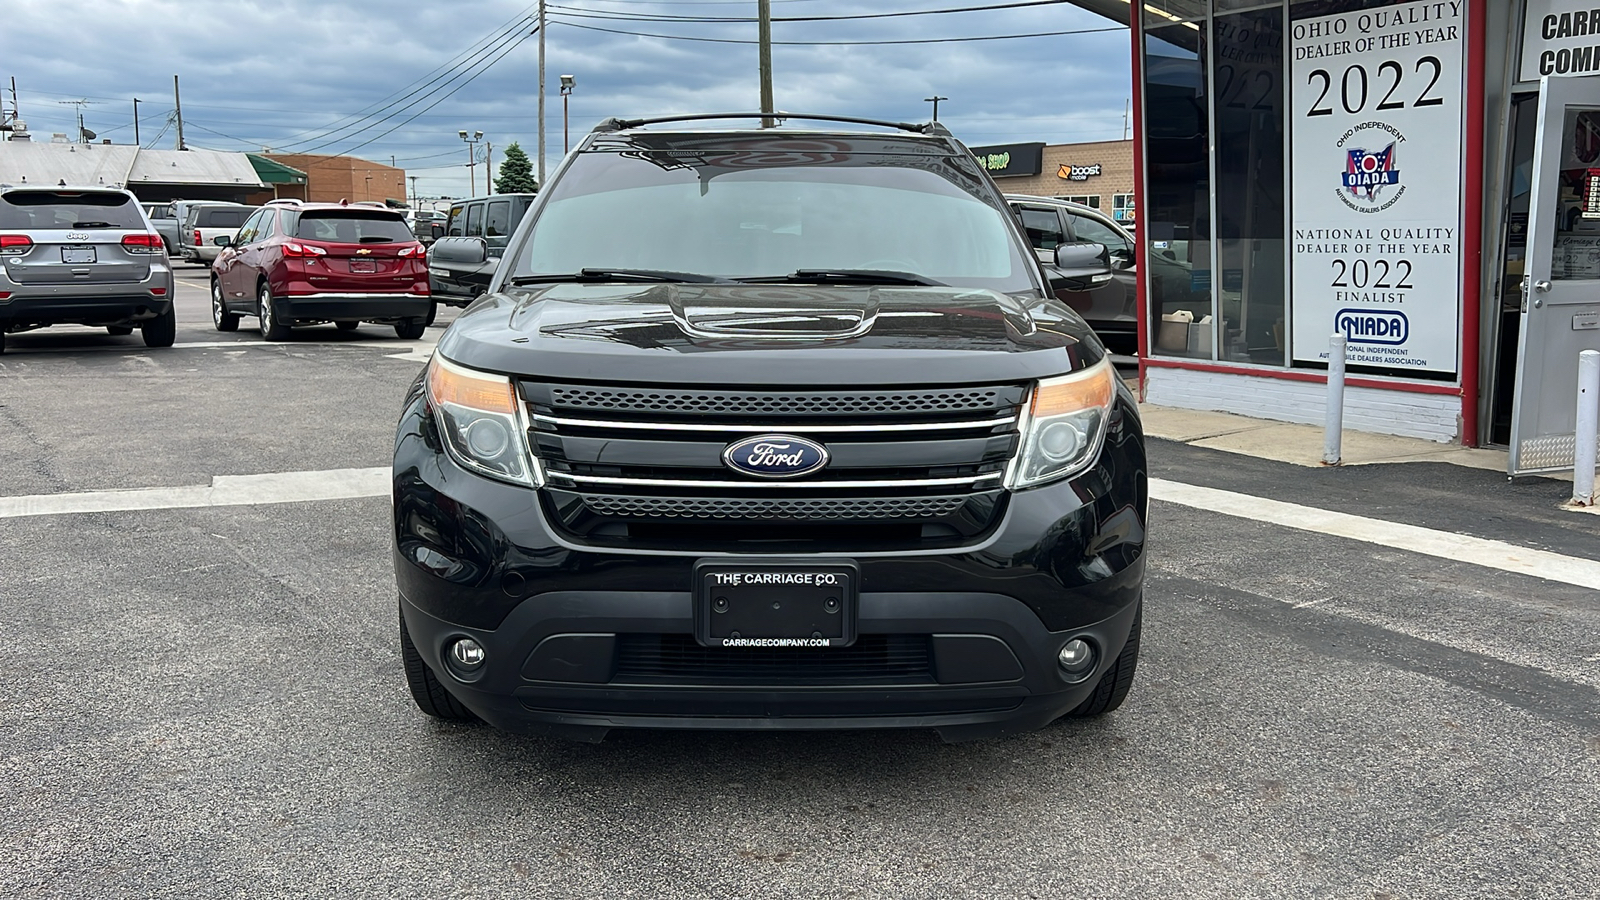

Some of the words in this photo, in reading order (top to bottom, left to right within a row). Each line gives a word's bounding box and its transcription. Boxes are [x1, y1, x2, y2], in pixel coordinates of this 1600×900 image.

[1293, 18, 1347, 40] OHIO
[1357, 0, 1461, 33] QUALITY
[1541, 9, 1600, 40] CARR
[1295, 40, 1351, 60] DEALER
[1355, 37, 1375, 53] OF
[1378, 32, 1410, 50] THE
[1414, 25, 1458, 45] YEAR
[1306, 55, 1443, 117] 2022
[1336, 129, 1354, 148] OHIO
[1353, 121, 1407, 144] INDEPENDENT
[988, 152, 1010, 170] SHOP
[1071, 164, 1100, 176] boost
[1348, 172, 1389, 186] OIADA
[1335, 188, 1359, 212] AUTOMOBILE
[1359, 206, 1380, 214] DEALERS
[1380, 185, 1407, 211] ASSOCIATION
[66, 232, 89, 241] Jeep
[1295, 229, 1374, 240] NATIONAL
[1380, 228, 1454, 241] QUALITY
[1297, 244, 1348, 254] DEALER
[1354, 244, 1372, 254] OF
[1378, 244, 1406, 254] THE
[1412, 244, 1451, 254] YEAR
[1331, 259, 1414, 289] 2022
[1336, 291, 1406, 303] FINALIST
[1341, 316, 1401, 337] NIADA
[1366, 347, 1408, 355] INDEPENDENT
[1357, 355, 1383, 363] DEALERS
[1384, 357, 1427, 366] ASSOCIATION
[747, 442, 804, 466] Ford
[715, 573, 741, 585] THE
[744, 574, 812, 584] CARRIAGE
[815, 574, 838, 585] CO.
[722, 639, 830, 647] CARRIAGECOMPANY.COM
